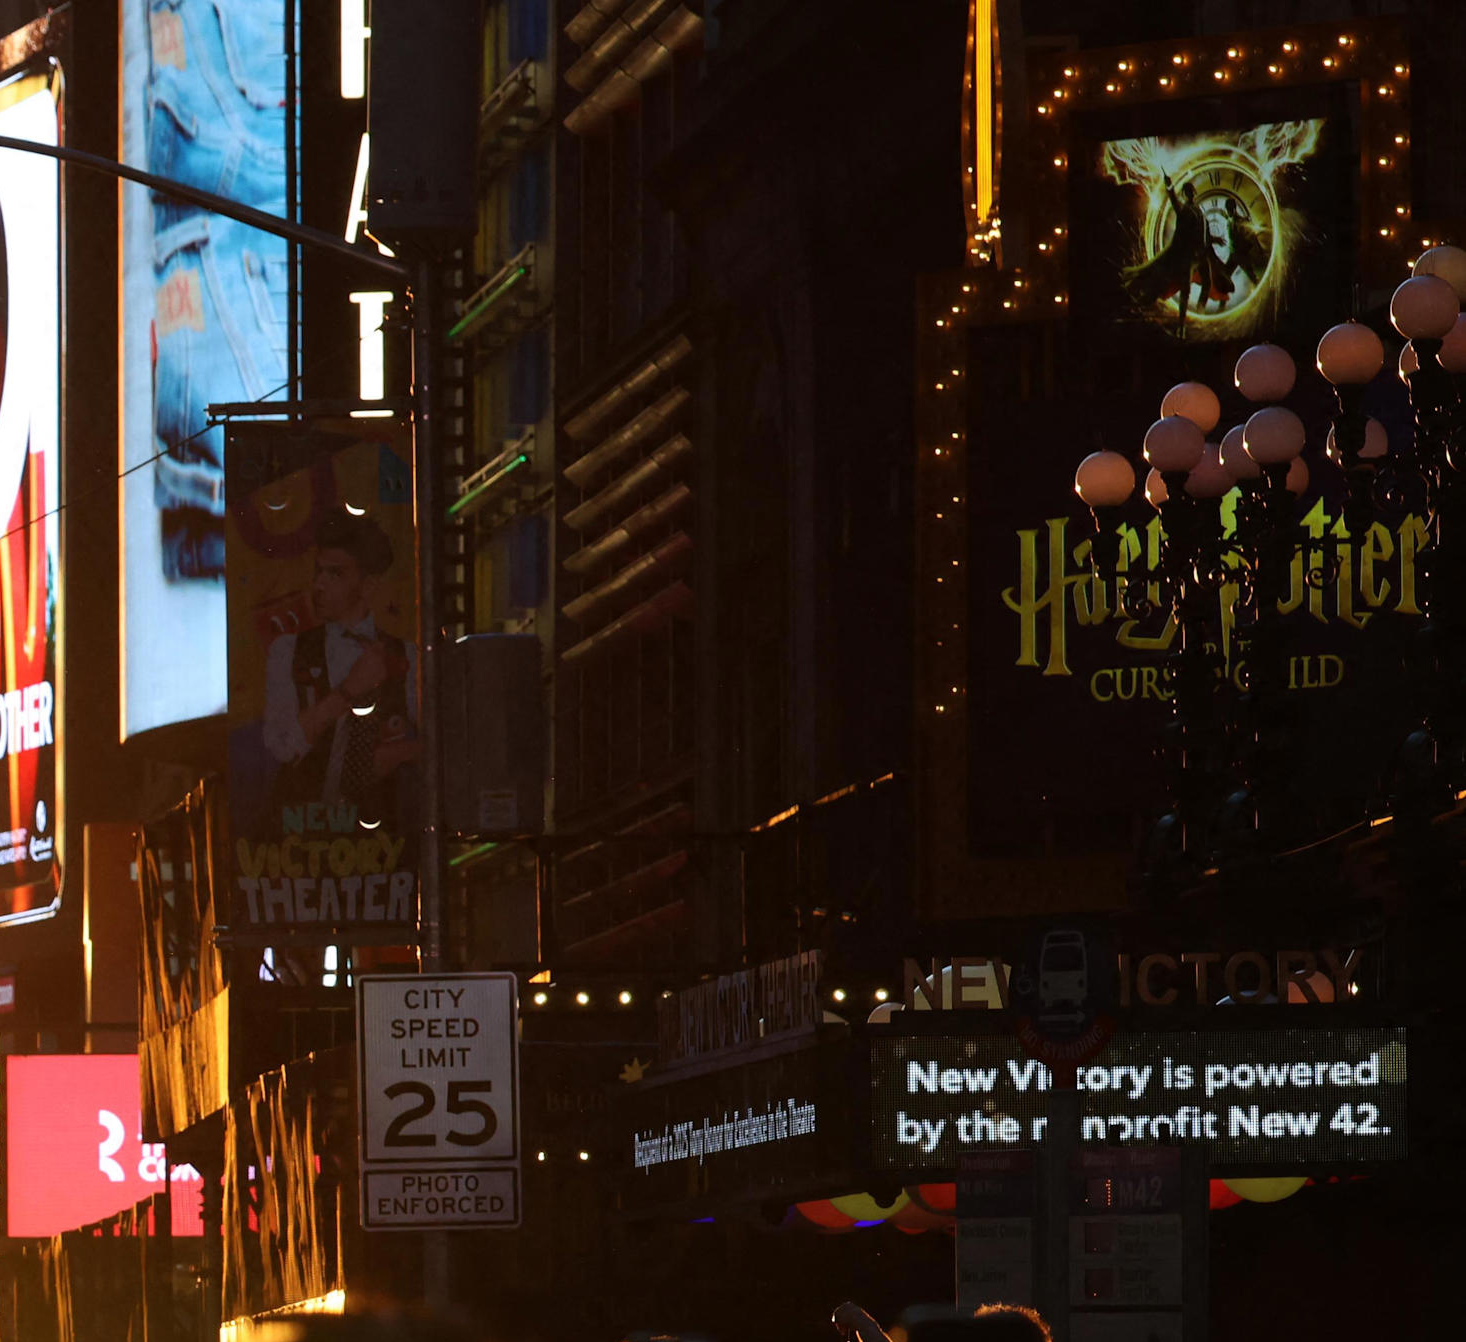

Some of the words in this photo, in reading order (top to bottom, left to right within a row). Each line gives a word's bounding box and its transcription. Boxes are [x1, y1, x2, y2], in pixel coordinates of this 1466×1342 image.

[281, 802, 358, 834] NEW
[235, 830, 406, 879] VICTORY
[237, 871, 415, 924] THEATER
[1117, 949, 1363, 1007] ICTORY
[404, 988, 465, 1009] CITY
[390, 1018, 479, 1039] SPEED
[401, 1048, 472, 1069] LIMIT
[906, 1059, 1000, 1093] New
[1006, 1057, 1153, 1100] Viory
[1163, 1056, 1195, 1090] is
[1204, 1052, 1380, 1098] powered
[383, 1080, 498, 1148] 25
[896, 1110, 946, 1152] by
[955, 1110, 1022, 1143] the
[1032, 1106, 1218, 1141] nnprofit
[1228, 1105, 1320, 1138] New
[1329, 1102, 1392, 1136] 42.
[402, 1175, 480, 1194] PHOTO
[1119, 1176, 1163, 1208] M42
[378, 1195, 504, 1216] ENFORCED
